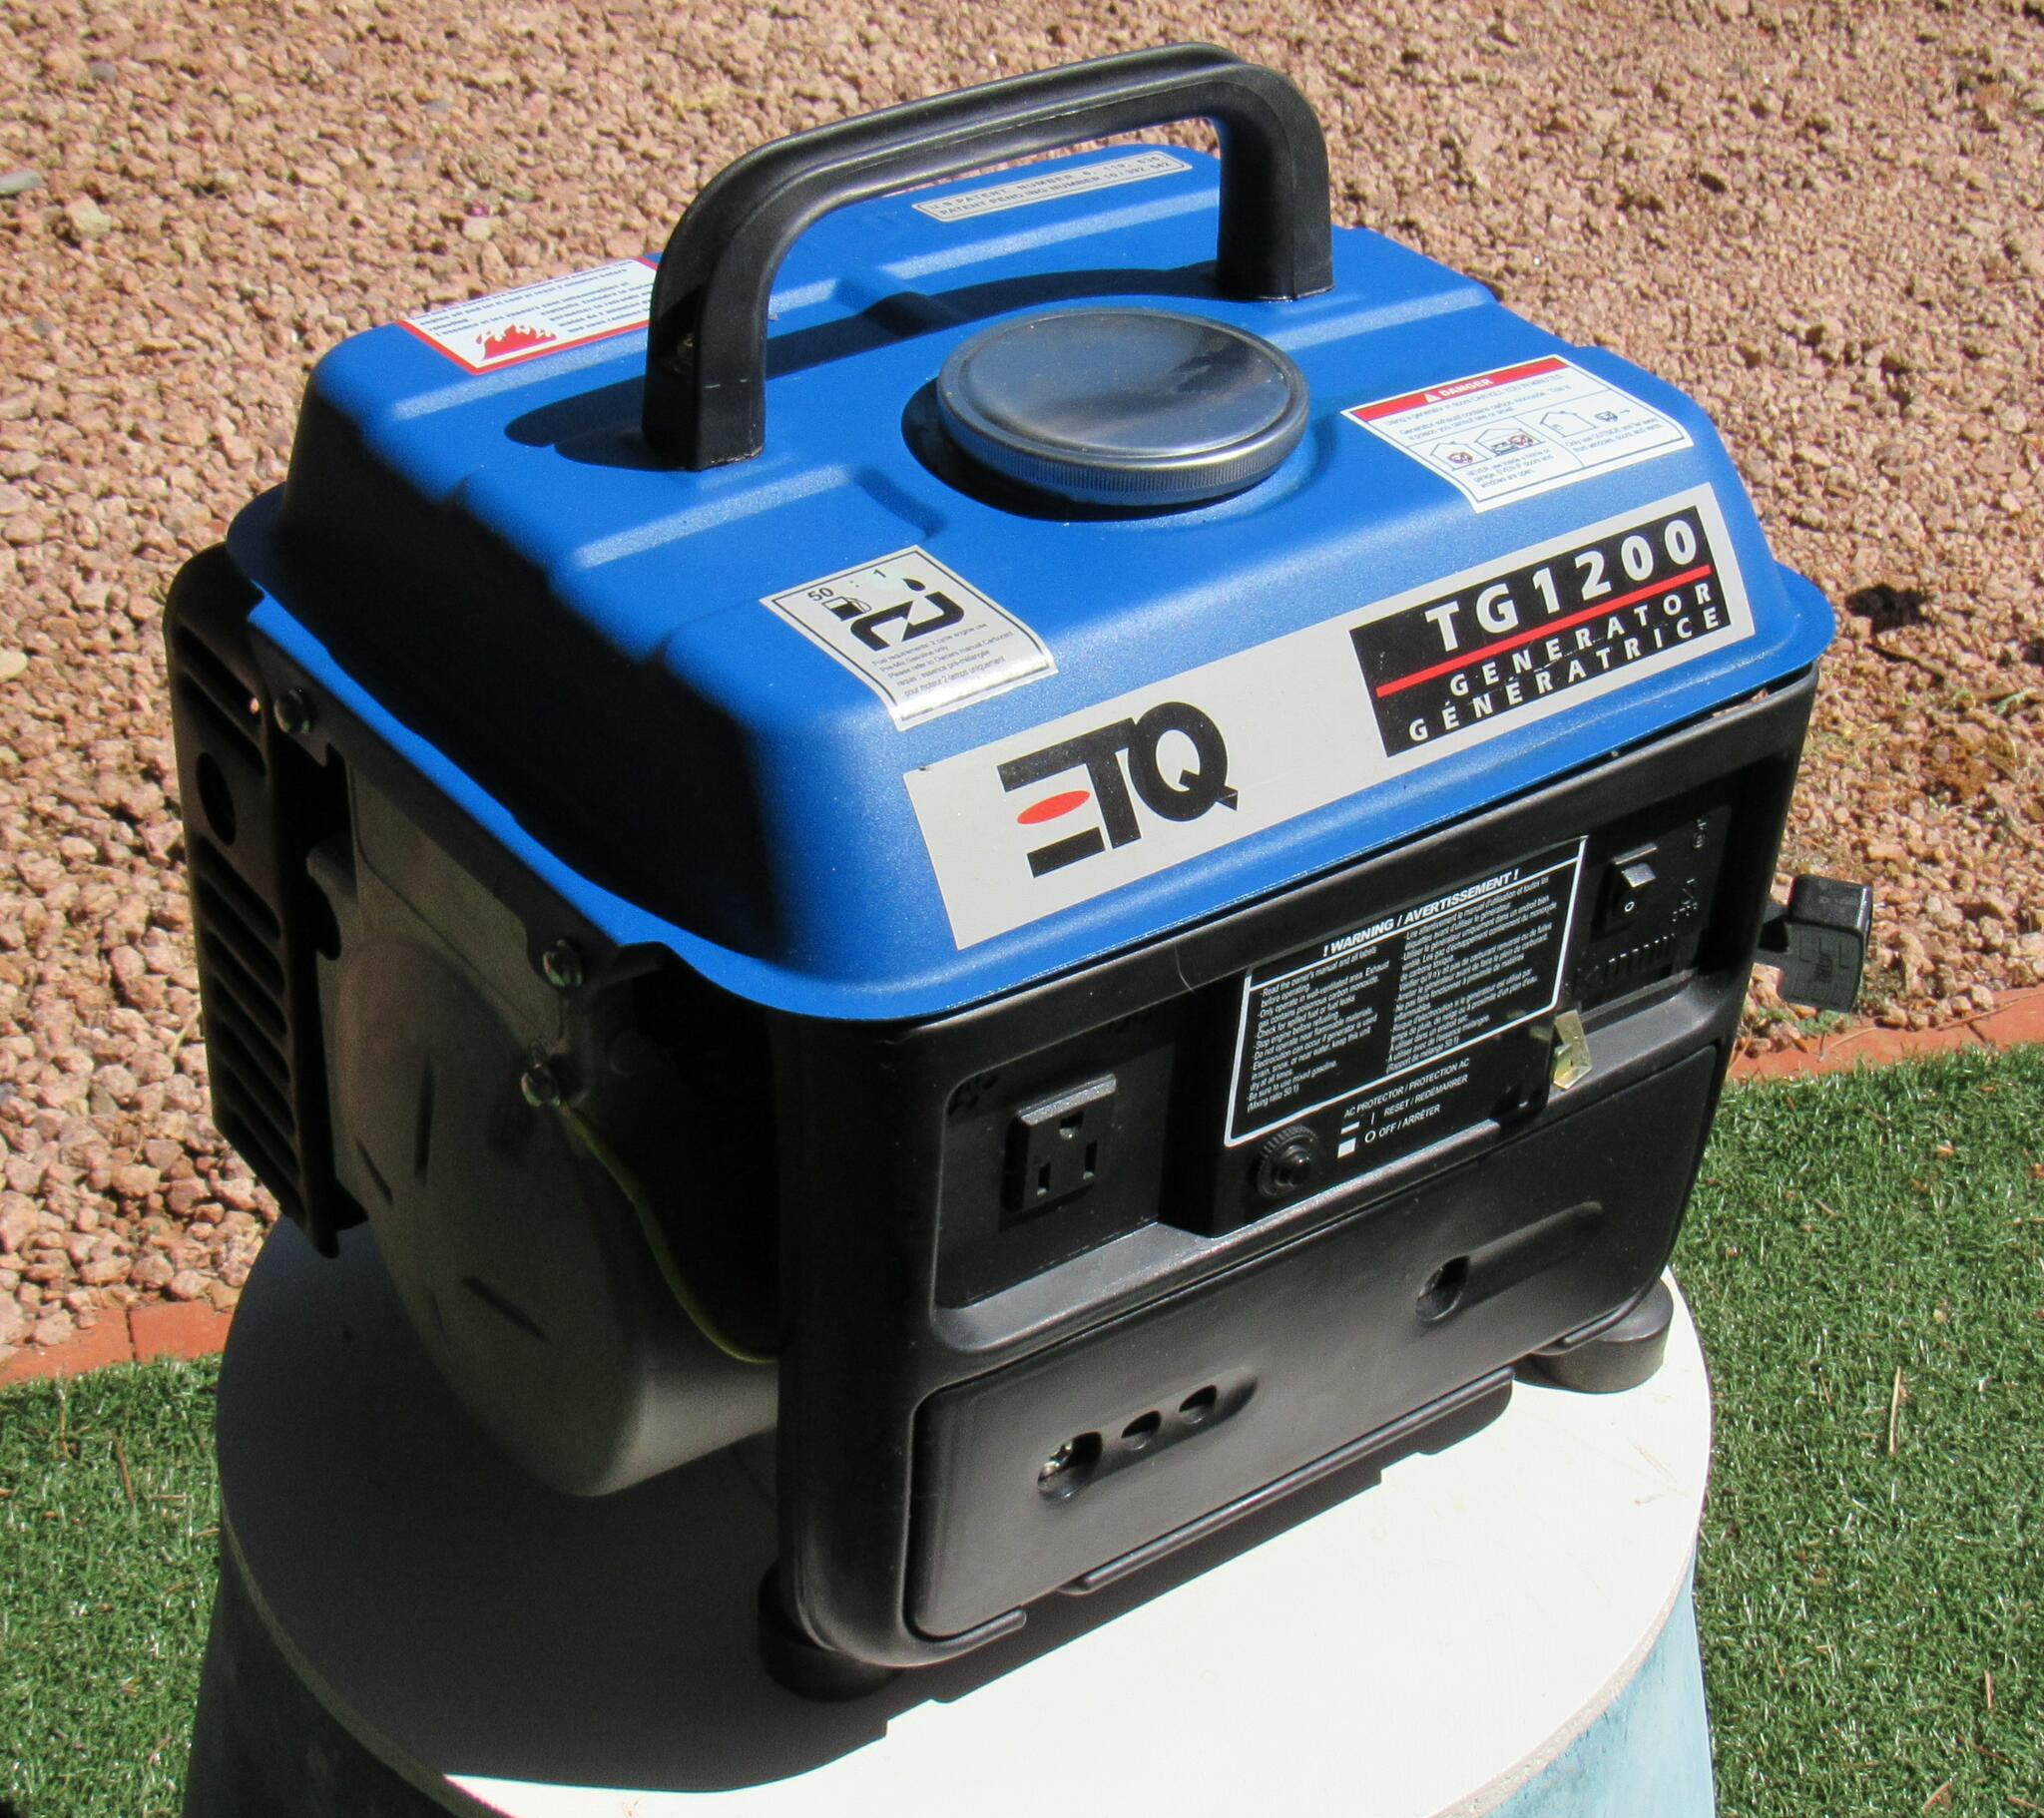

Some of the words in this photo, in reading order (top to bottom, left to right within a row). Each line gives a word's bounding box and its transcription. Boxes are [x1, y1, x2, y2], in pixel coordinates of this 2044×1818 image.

[1437, 378, 1494, 396] DANGER
[807, 587, 833, 601] 50
[873, 569, 886, 578] 1
[1425, 519, 1698, 653] TG1200
[1408, 607, 1720, 741] GÉNÉRATRICE
[1450, 583, 1711, 696] GENERATOR
[997, 701, 1238, 878] ETQ
[1330, 918, 1392, 953] WARNING
[1404, 871, 1510, 924] AVERTISSEMENT
[1344, 1107, 1354, 1118] AC
[1357, 1086, 1402, 1113] PROTECTOR
[1409, 1063, 1457, 1090] PROTECTION
[1458, 1058, 1469, 1069] AC
[1379, 1123, 1395, 1136] OFF
[1402, 1102, 1440, 1127] ARRÊTER
[1384, 1099, 1409, 1117] RESET
